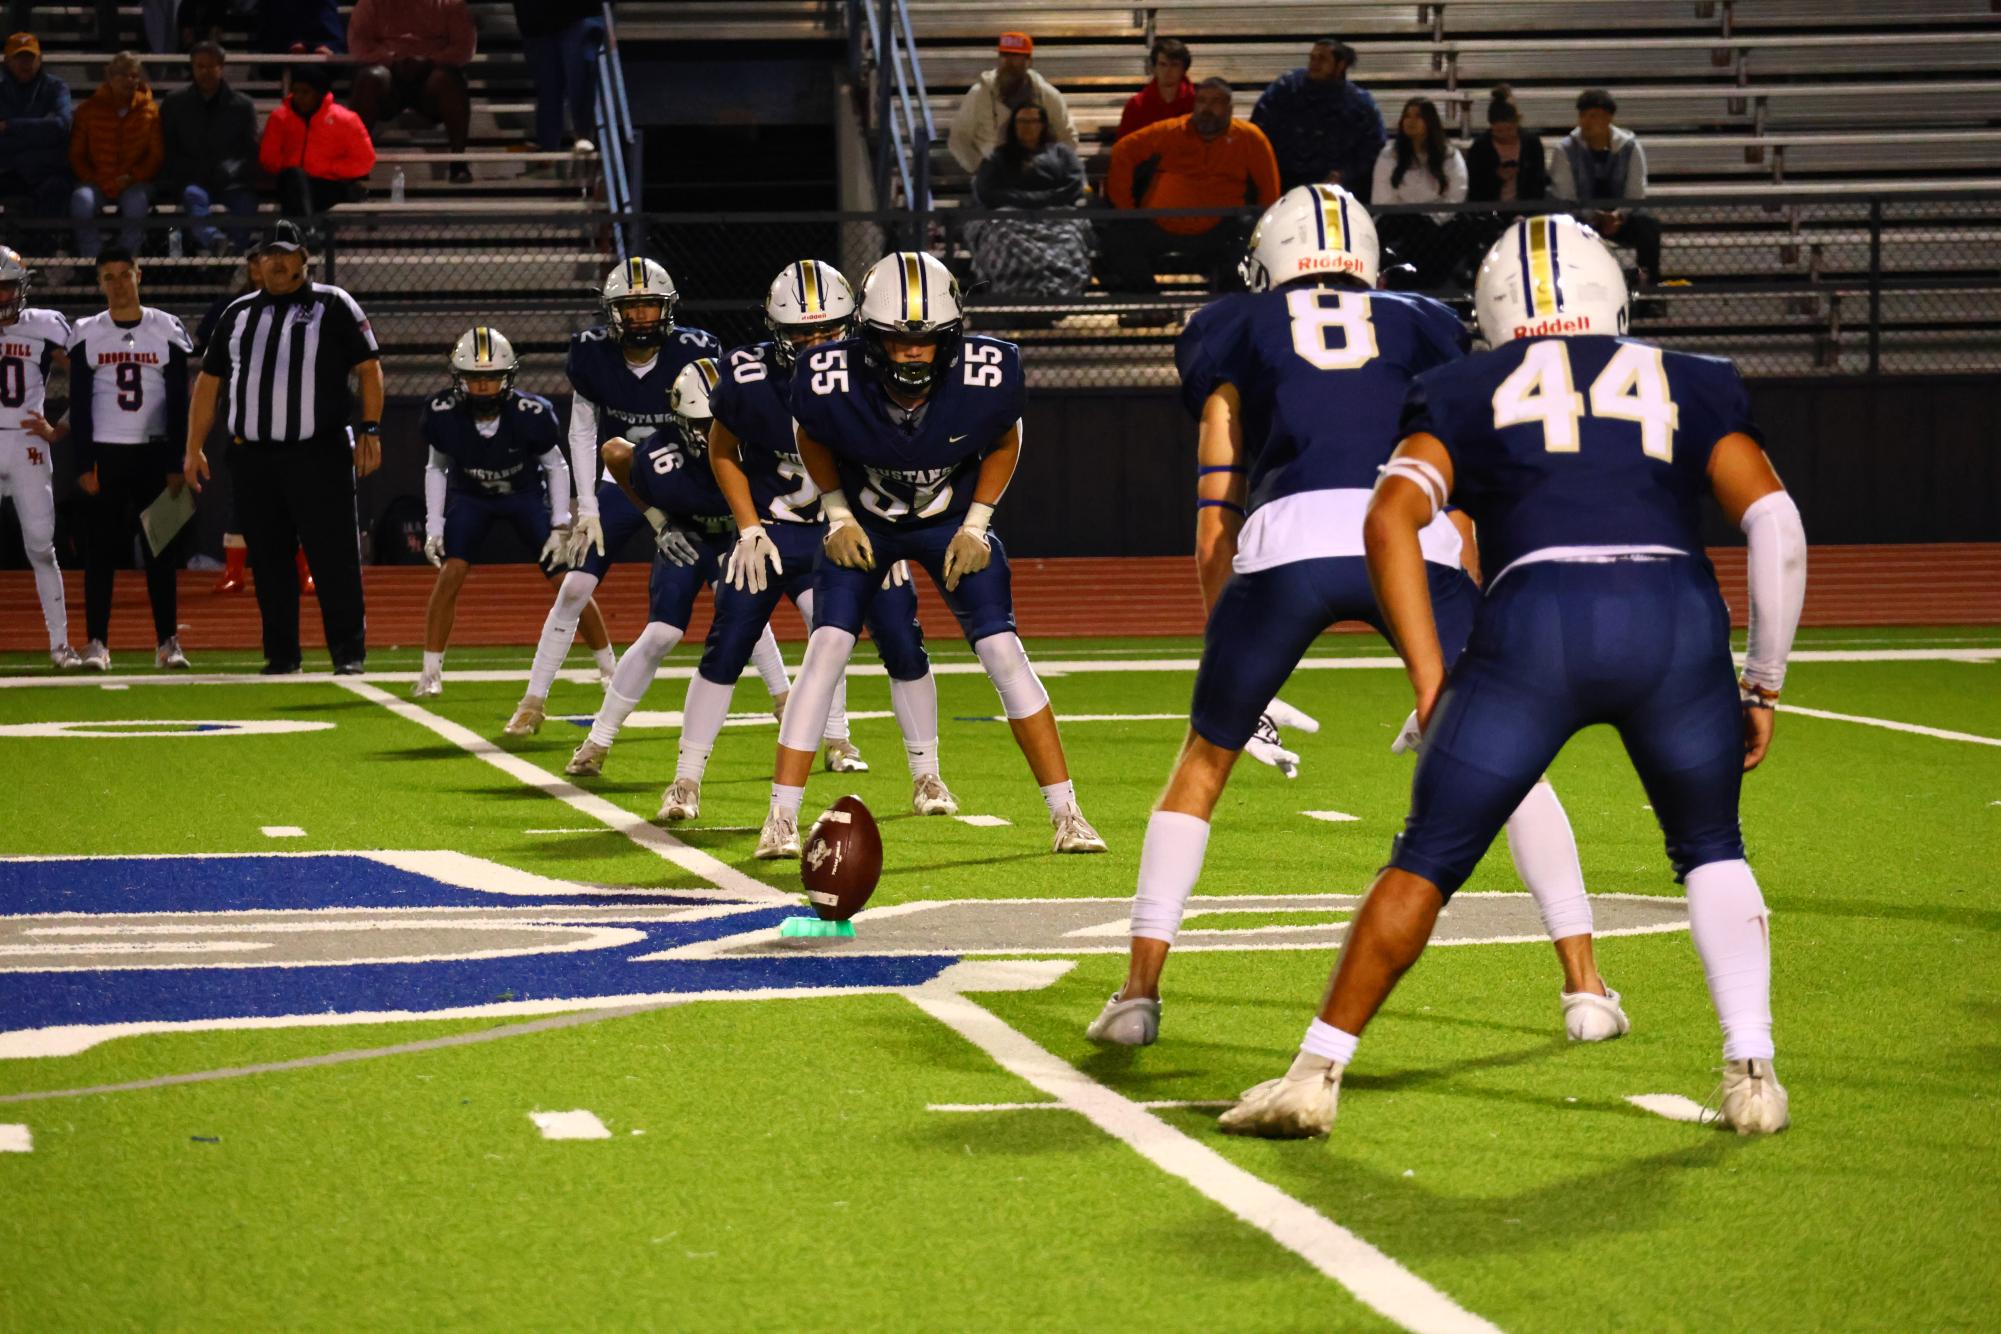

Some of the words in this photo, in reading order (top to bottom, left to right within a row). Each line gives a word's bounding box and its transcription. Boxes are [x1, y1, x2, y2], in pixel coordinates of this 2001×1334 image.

[1297, 256, 1364, 273] Riddell
[1285, 285, 1380, 371] 8
[1513, 315, 1590, 340] Riddell
[134, 352, 160, 364] HILL
[731, 347, 768, 384] 20
[810, 350, 849, 396] 55
[964, 342, 1003, 388] 55
[116, 362, 144, 412] 9
[1491, 339, 1679, 464] 44
[518, 398, 543, 415] 3
[648, 442, 685, 475] 16
